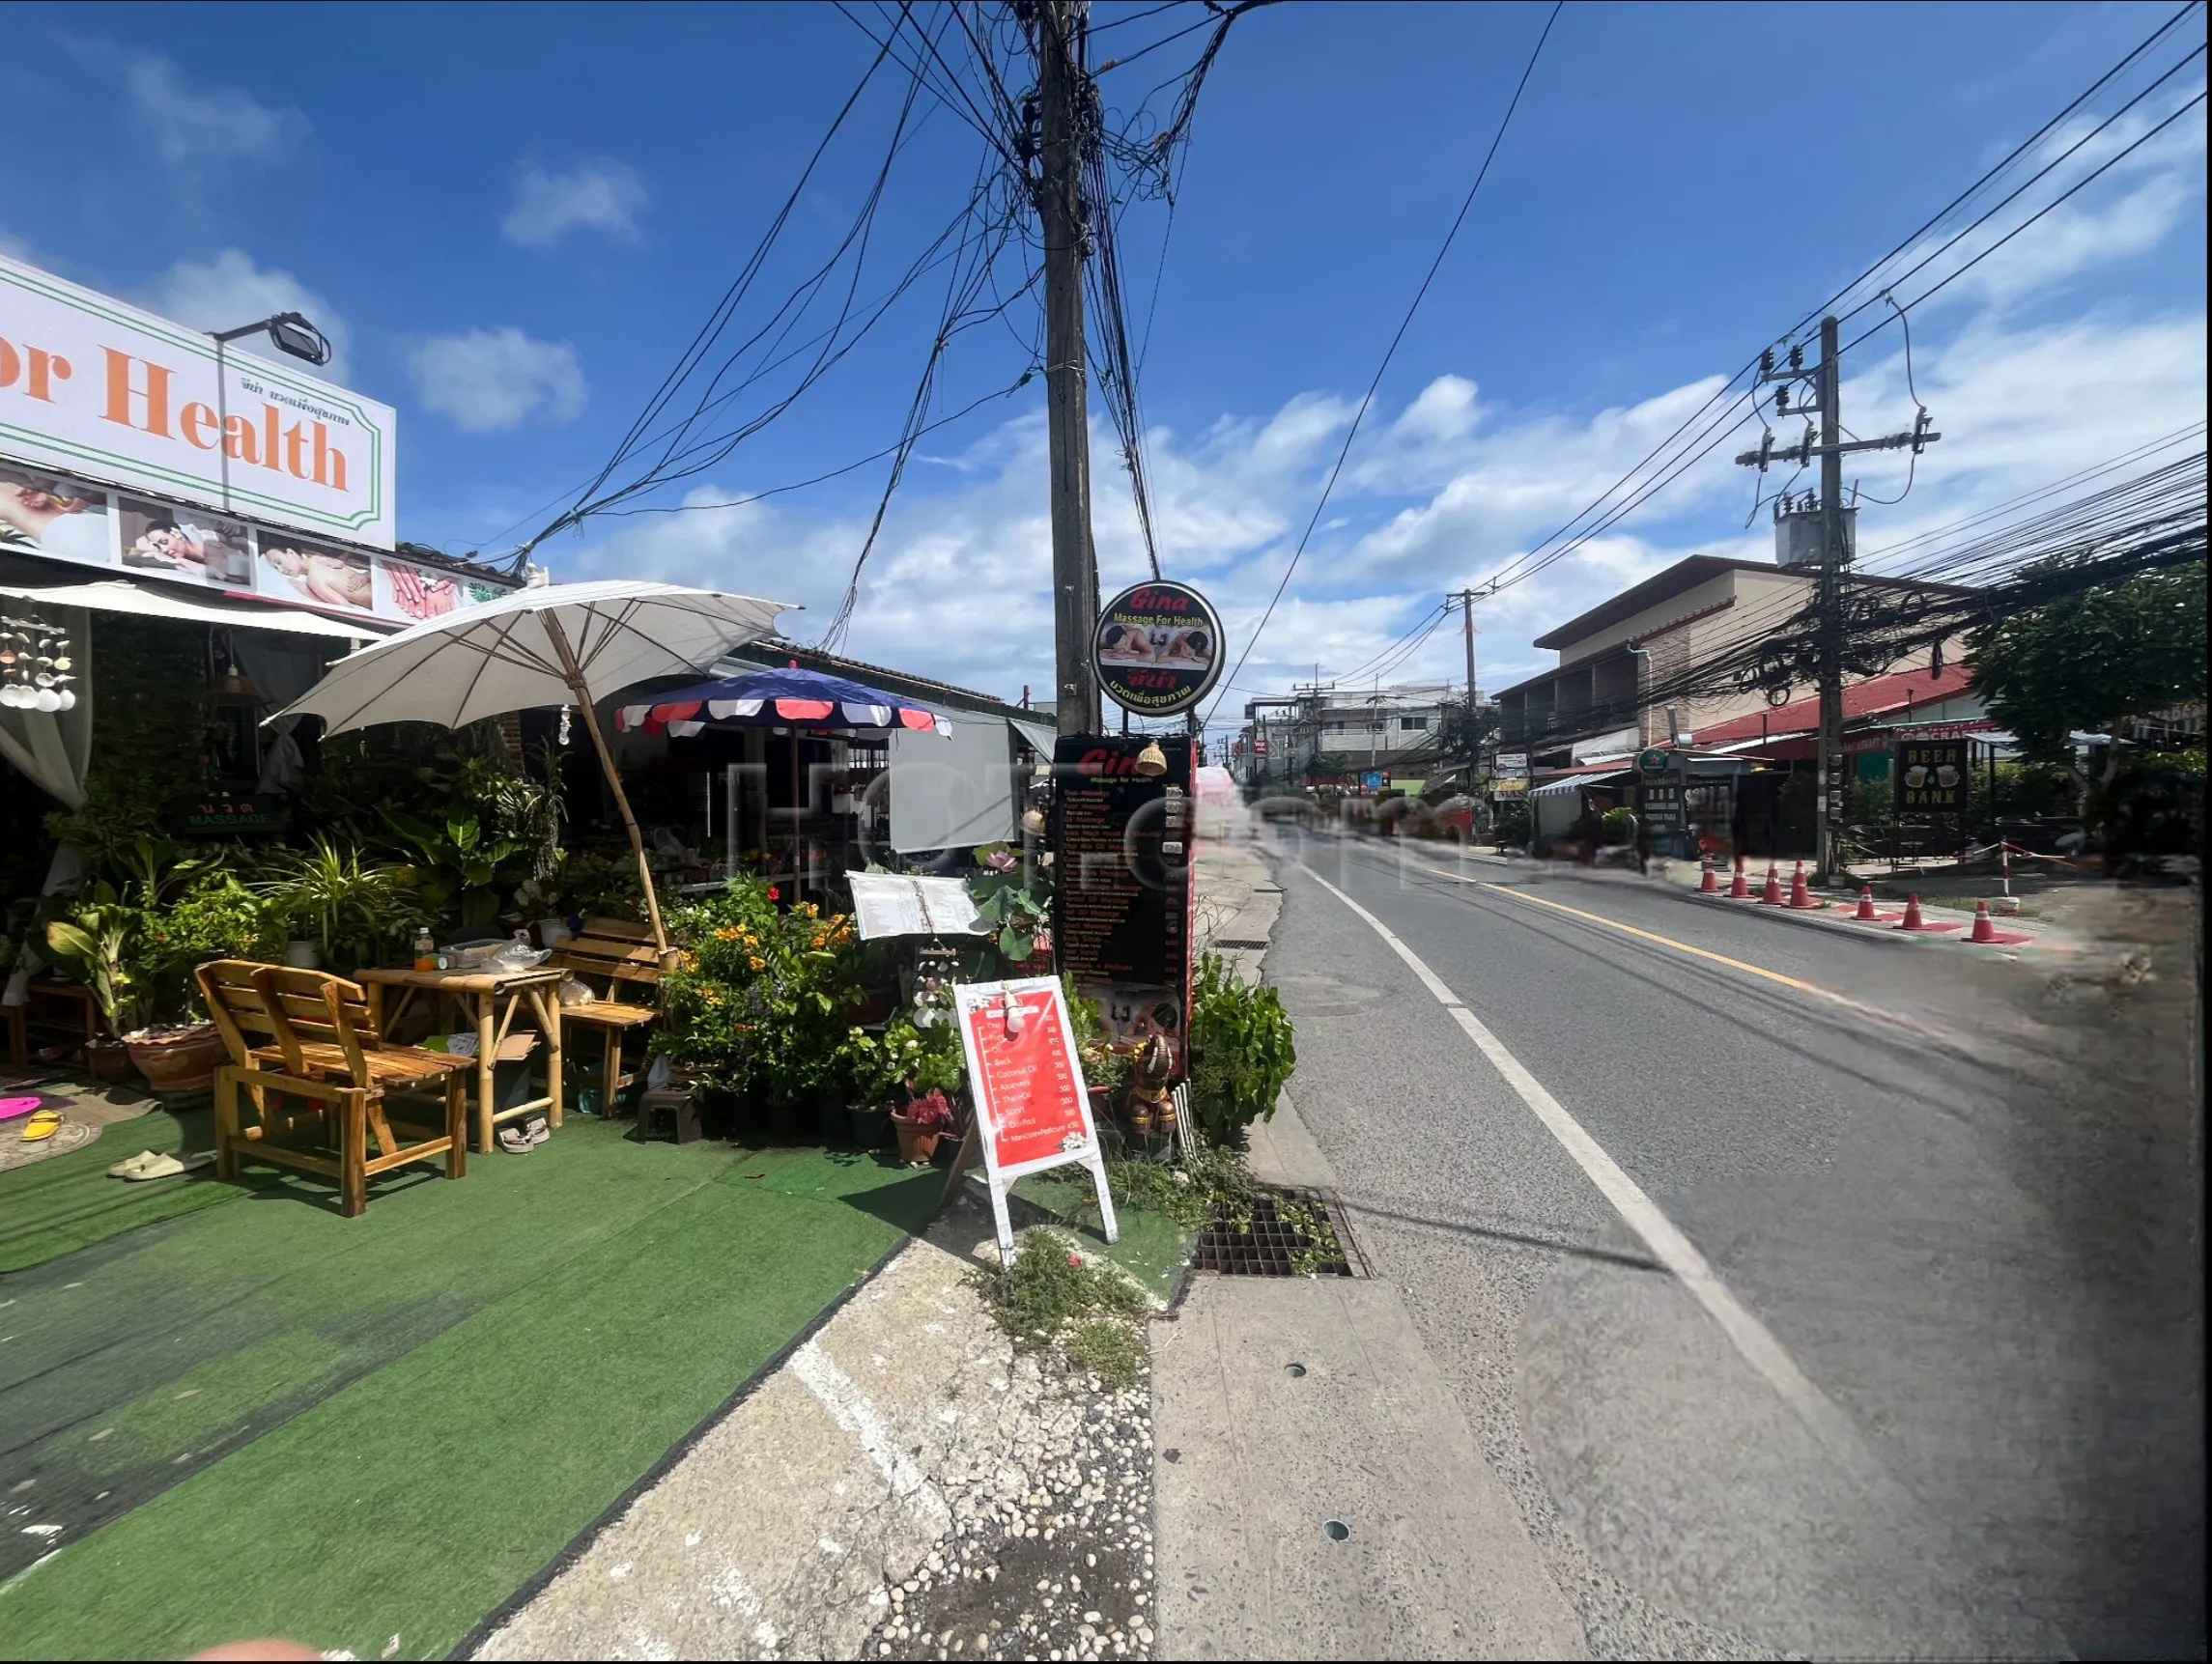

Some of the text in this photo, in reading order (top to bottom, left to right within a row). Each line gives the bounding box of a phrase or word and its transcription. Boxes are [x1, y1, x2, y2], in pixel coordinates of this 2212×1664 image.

[98, 344, 350, 493] Health
[1129, 588, 1190, 611] Gina
[1113, 612, 1204, 627] Massage For Health
[1109, 679, 1192, 706] นวดเพื่อสุขภาพ
[1907, 748, 1957, 764] BEER
[1906, 790, 1955, 804] BANK
[189, 813, 272, 827] MASSAGE
